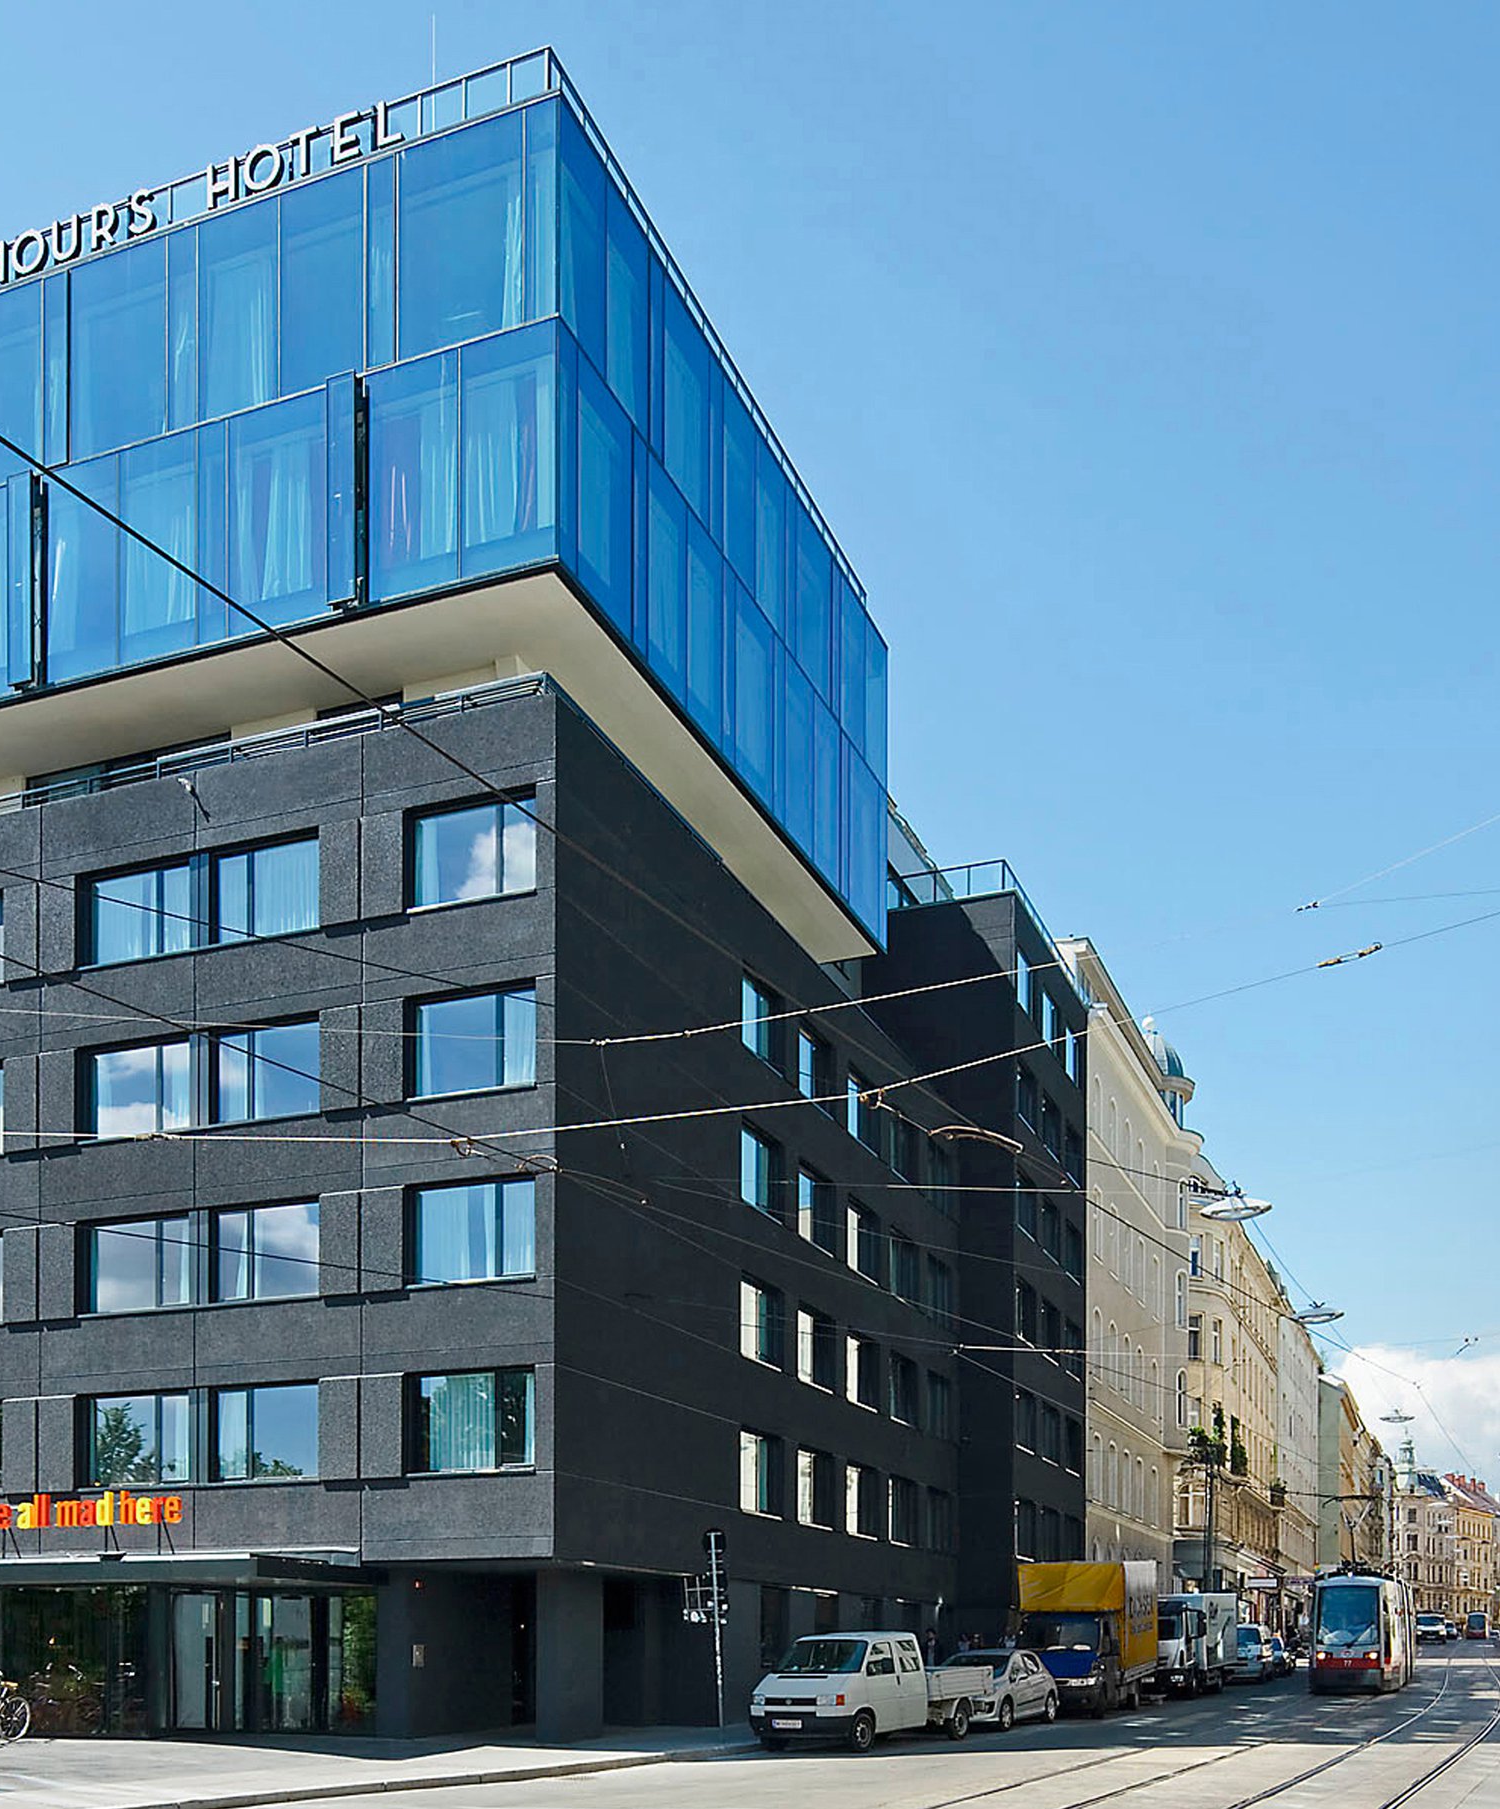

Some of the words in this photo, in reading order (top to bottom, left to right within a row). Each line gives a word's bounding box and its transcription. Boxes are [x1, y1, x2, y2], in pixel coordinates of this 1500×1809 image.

[206, 100, 404, 209] HOTEL
[16, 1494, 51, 1529] all
[56, 1491, 114, 1527] mad
[120, 1490, 182, 1524] here
